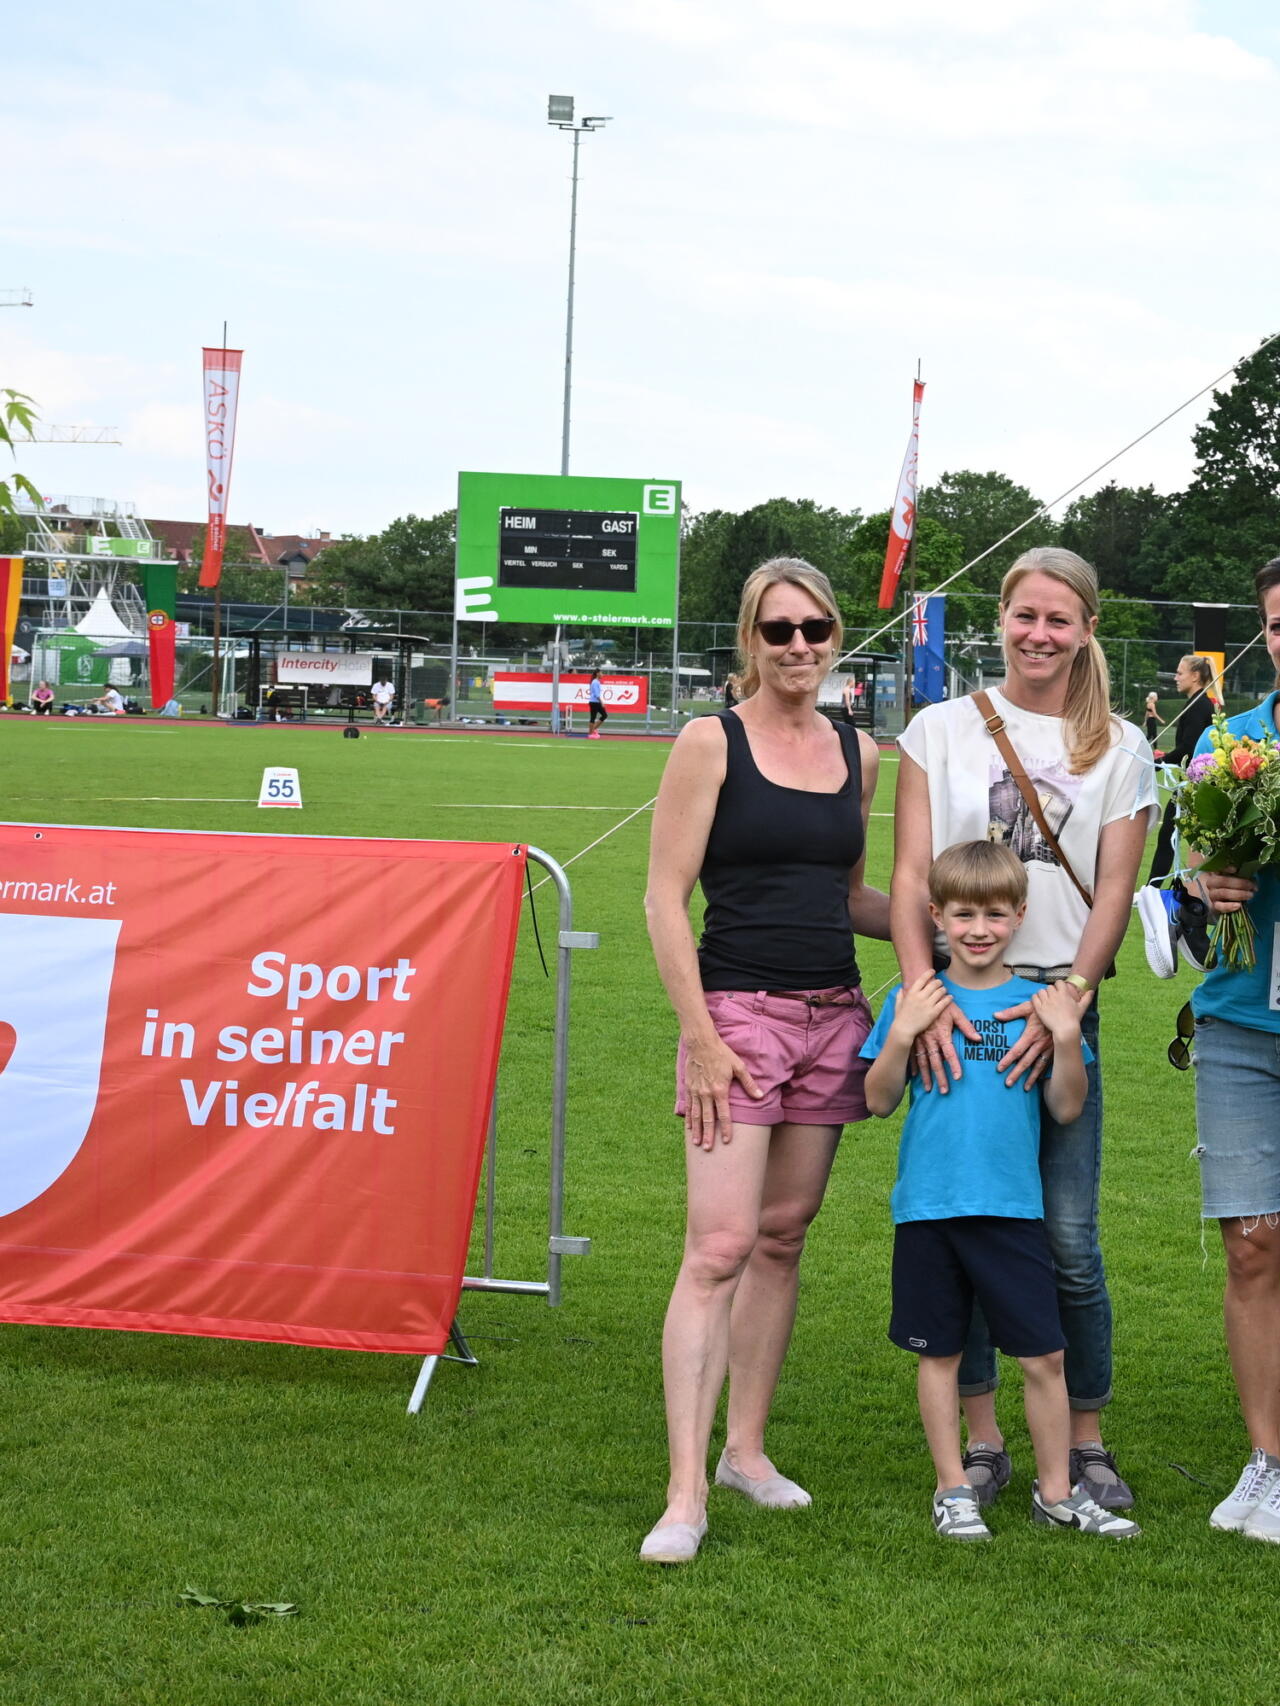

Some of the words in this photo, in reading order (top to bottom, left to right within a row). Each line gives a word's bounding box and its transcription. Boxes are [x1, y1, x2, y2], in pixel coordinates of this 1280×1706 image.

[504, 516, 537, 530] HEIM
[601, 520, 634, 534] GAST
[524, 545, 538, 554] MIN
[602, 549, 617, 558] SEK
[503, 559, 527, 568] VIERTEL
[531, 560, 558, 568] VERSUCH
[572, 562, 584, 570] SEK
[609, 563, 629, 571] YARDS
[574, 687, 614, 701] ASÖ
[267, 778, 294, 798] 55
[0, 878, 118, 905] rmark.at
[246, 951, 417, 1010] Sport
[967, 1019, 1006, 1034] ORST
[140, 1009, 195, 1059] in
[216, 1017, 405, 1066] seiner
[180, 1079, 398, 1134] Vielfalt
